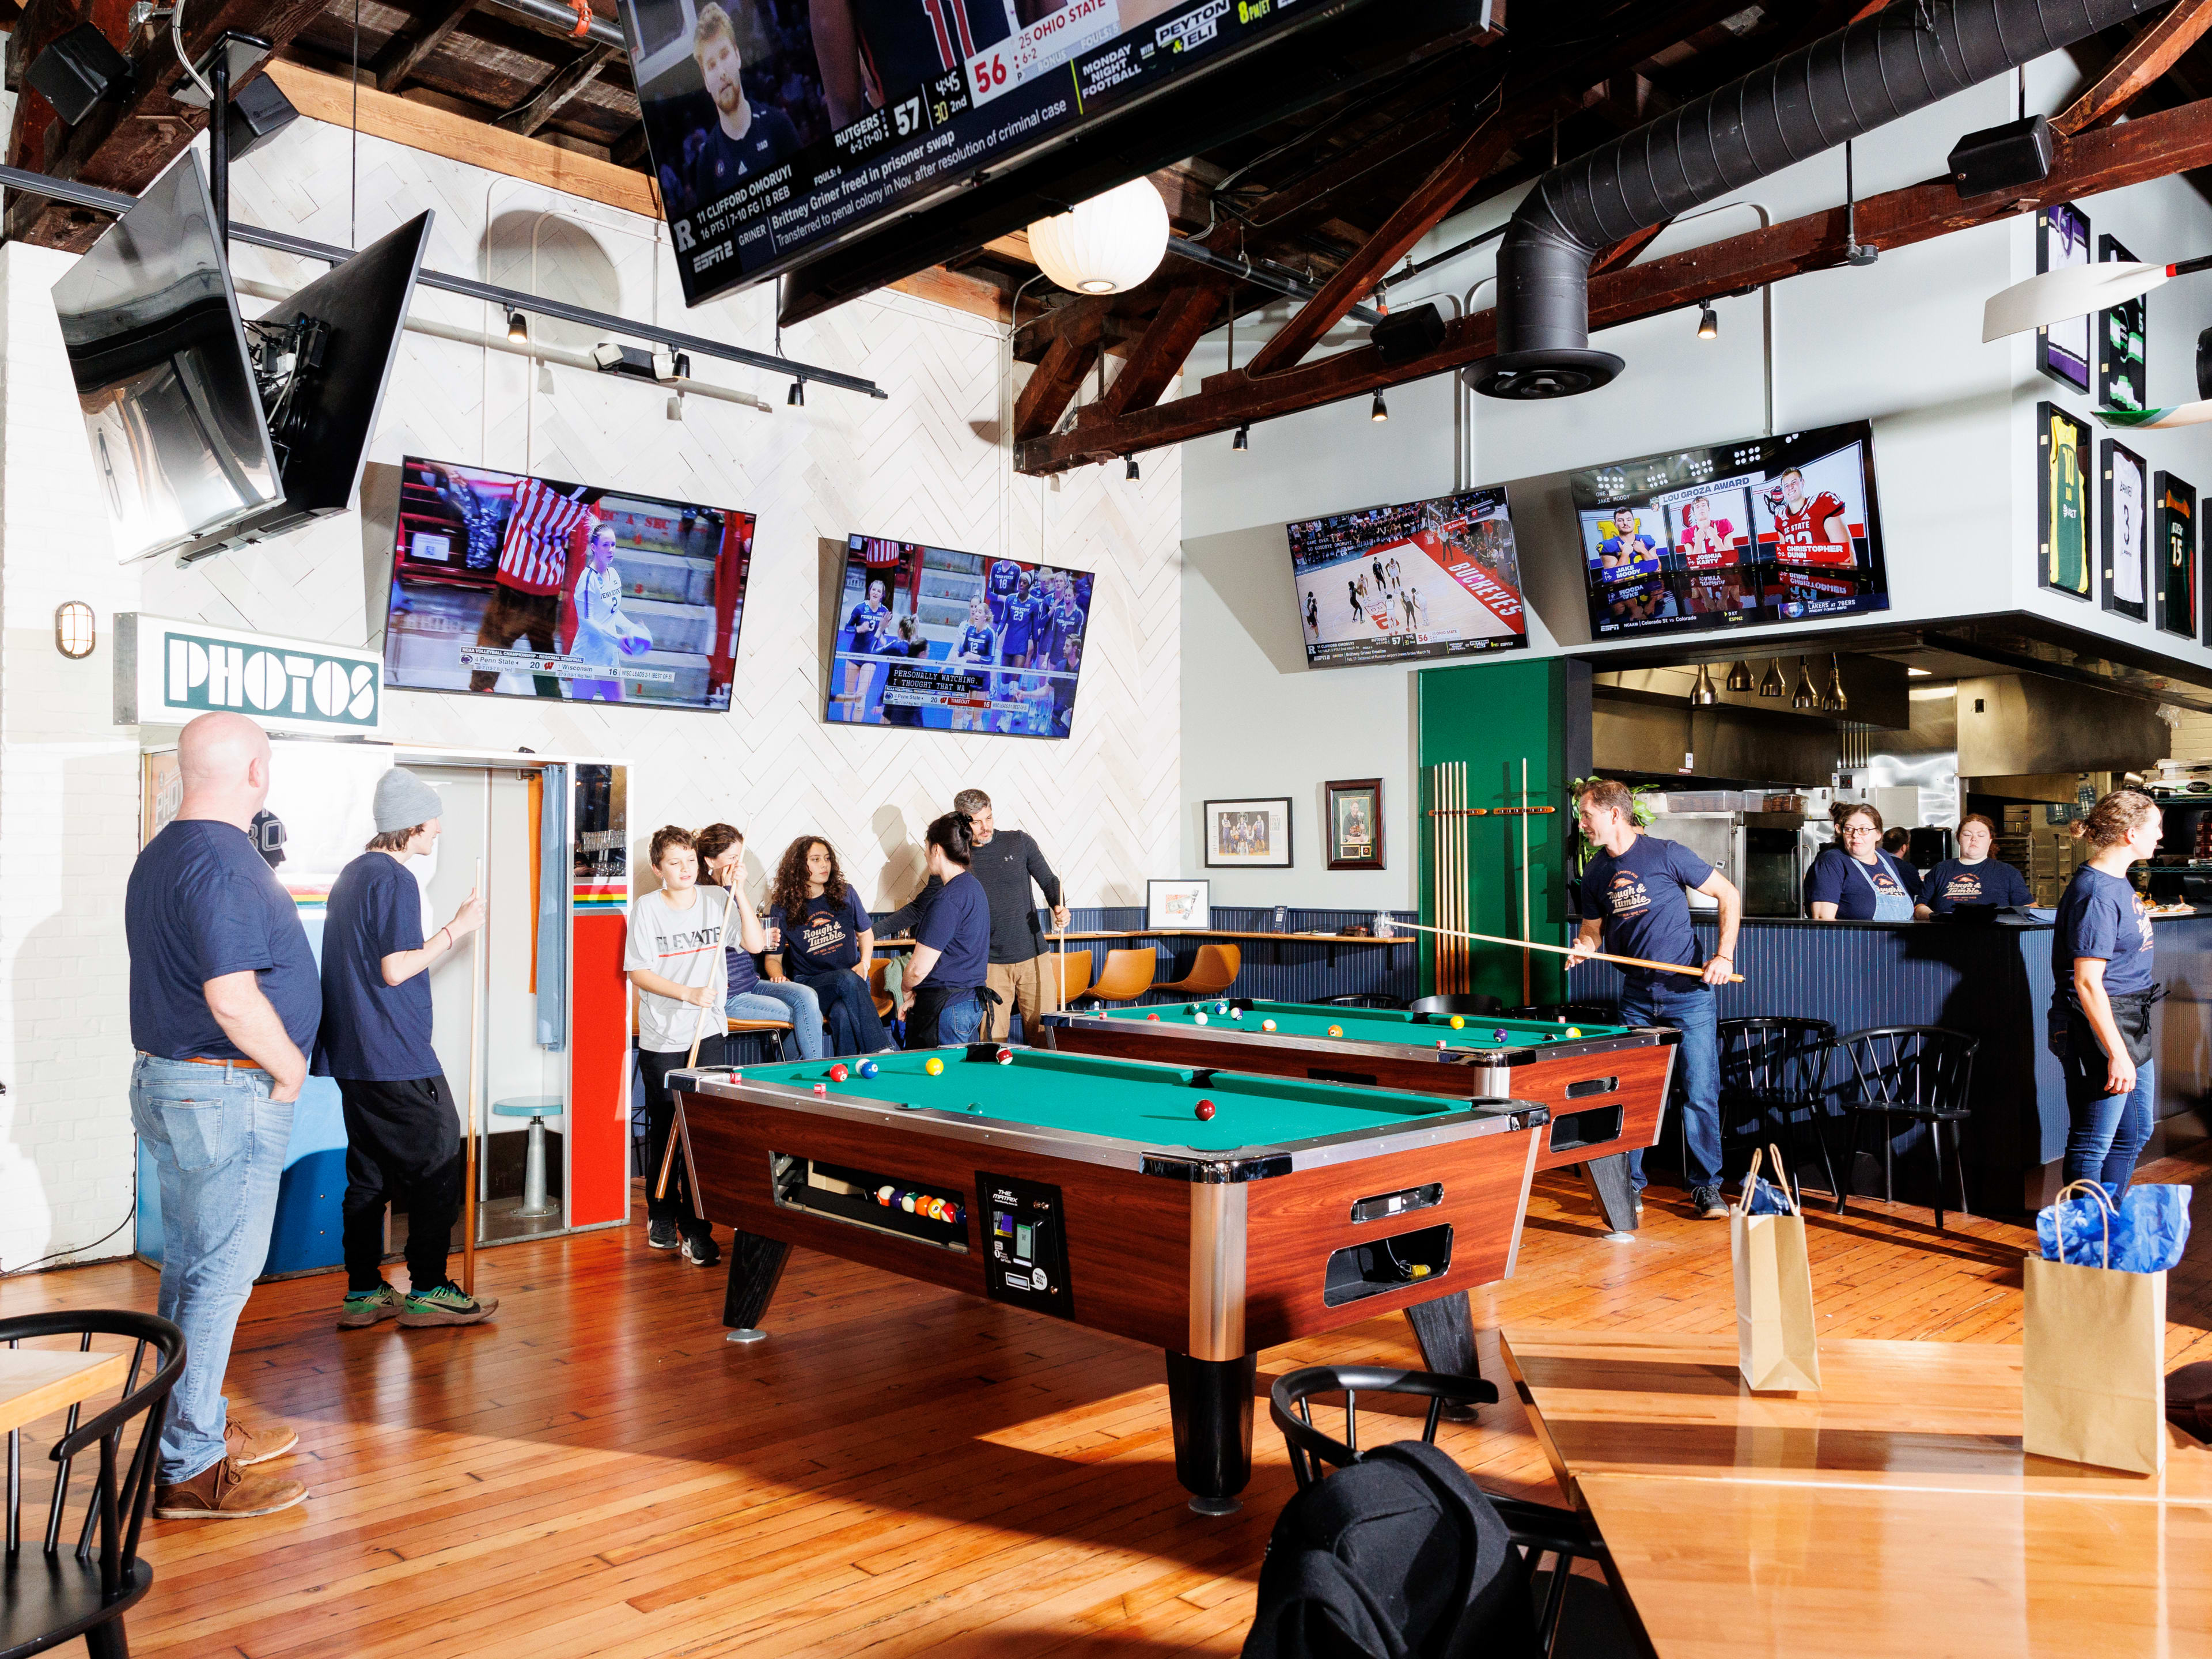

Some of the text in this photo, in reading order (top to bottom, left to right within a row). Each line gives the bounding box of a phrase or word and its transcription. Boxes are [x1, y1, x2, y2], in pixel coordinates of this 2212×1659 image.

[1018, 35, 1032, 50] 25
[1033, 14, 1065, 40] OHIO
[1159, 2, 1228, 42] PEYTON
[1037, 28, 1112, 72] BONUS FOULS:
[1172, 25, 1213, 54] & ELI
[1022, 48, 1037, 63] 6-2
[1082, 44, 1132, 75] MONDAY
[974, 54, 1007, 93] 56
[1082, 64, 1142, 99] FOOTBALL
[1091, 58, 1127, 82] NIGHT
[935, 71, 961, 96] 4:45
[835, 96, 919, 147] RUTGERS 57
[934, 94, 967, 124] 30 2nd
[850, 129, 882, 154] 6-2 (1-0)
[772, 130, 955, 229] Brittney Griner freed in prisoner swap
[776, 100, 1067, 247] Transferred to penal colony in Nov. after resolution of criminal case
[814, 165, 842, 187] FOULS: 6
[696, 164, 792, 224] 11 CLIFFORD OMORUYI
[700, 185, 790, 240] 16 PTS 7-10 FG 8 REB
[673, 219, 696, 253] R
[738, 224, 766, 247] GRINER
[1663, 477, 1749, 503] LOU GROZA AWARD
[1478, 506, 1491, 514] TOYOTA
[1791, 521, 1810, 530] STATE
[2124, 505, 2130, 545] 3
[1787, 544, 1843, 553] CHRISTOPHER
[2171, 536, 2182, 566] 15
[1616, 565, 1634, 573] JAKE
[1616, 569, 1641, 578] MOODY
[999, 579, 1007, 589] 18
[1448, 562, 1522, 616] BUCKEYES
[1013, 611, 1024, 622] 23
[970, 642, 978, 654] 12
[1308, 646, 1316, 654] R
[1392, 637, 1401, 645] 57
[169, 639, 374, 719] PHOTOS
[894, 669, 978, 684] PERSONALLY WATCHING.
[902, 679, 932, 688] THOUGHT
[936, 683, 953, 691] THAT
[1637, 883, 1646, 893] &
[1612, 894, 1646, 908] Tumble
[656, 926, 721, 952] ELEVATE
[803, 921, 842, 940] Rough &
[808, 930, 843, 946] Tumble
[993, 1194, 1018, 1203] MATRIX
